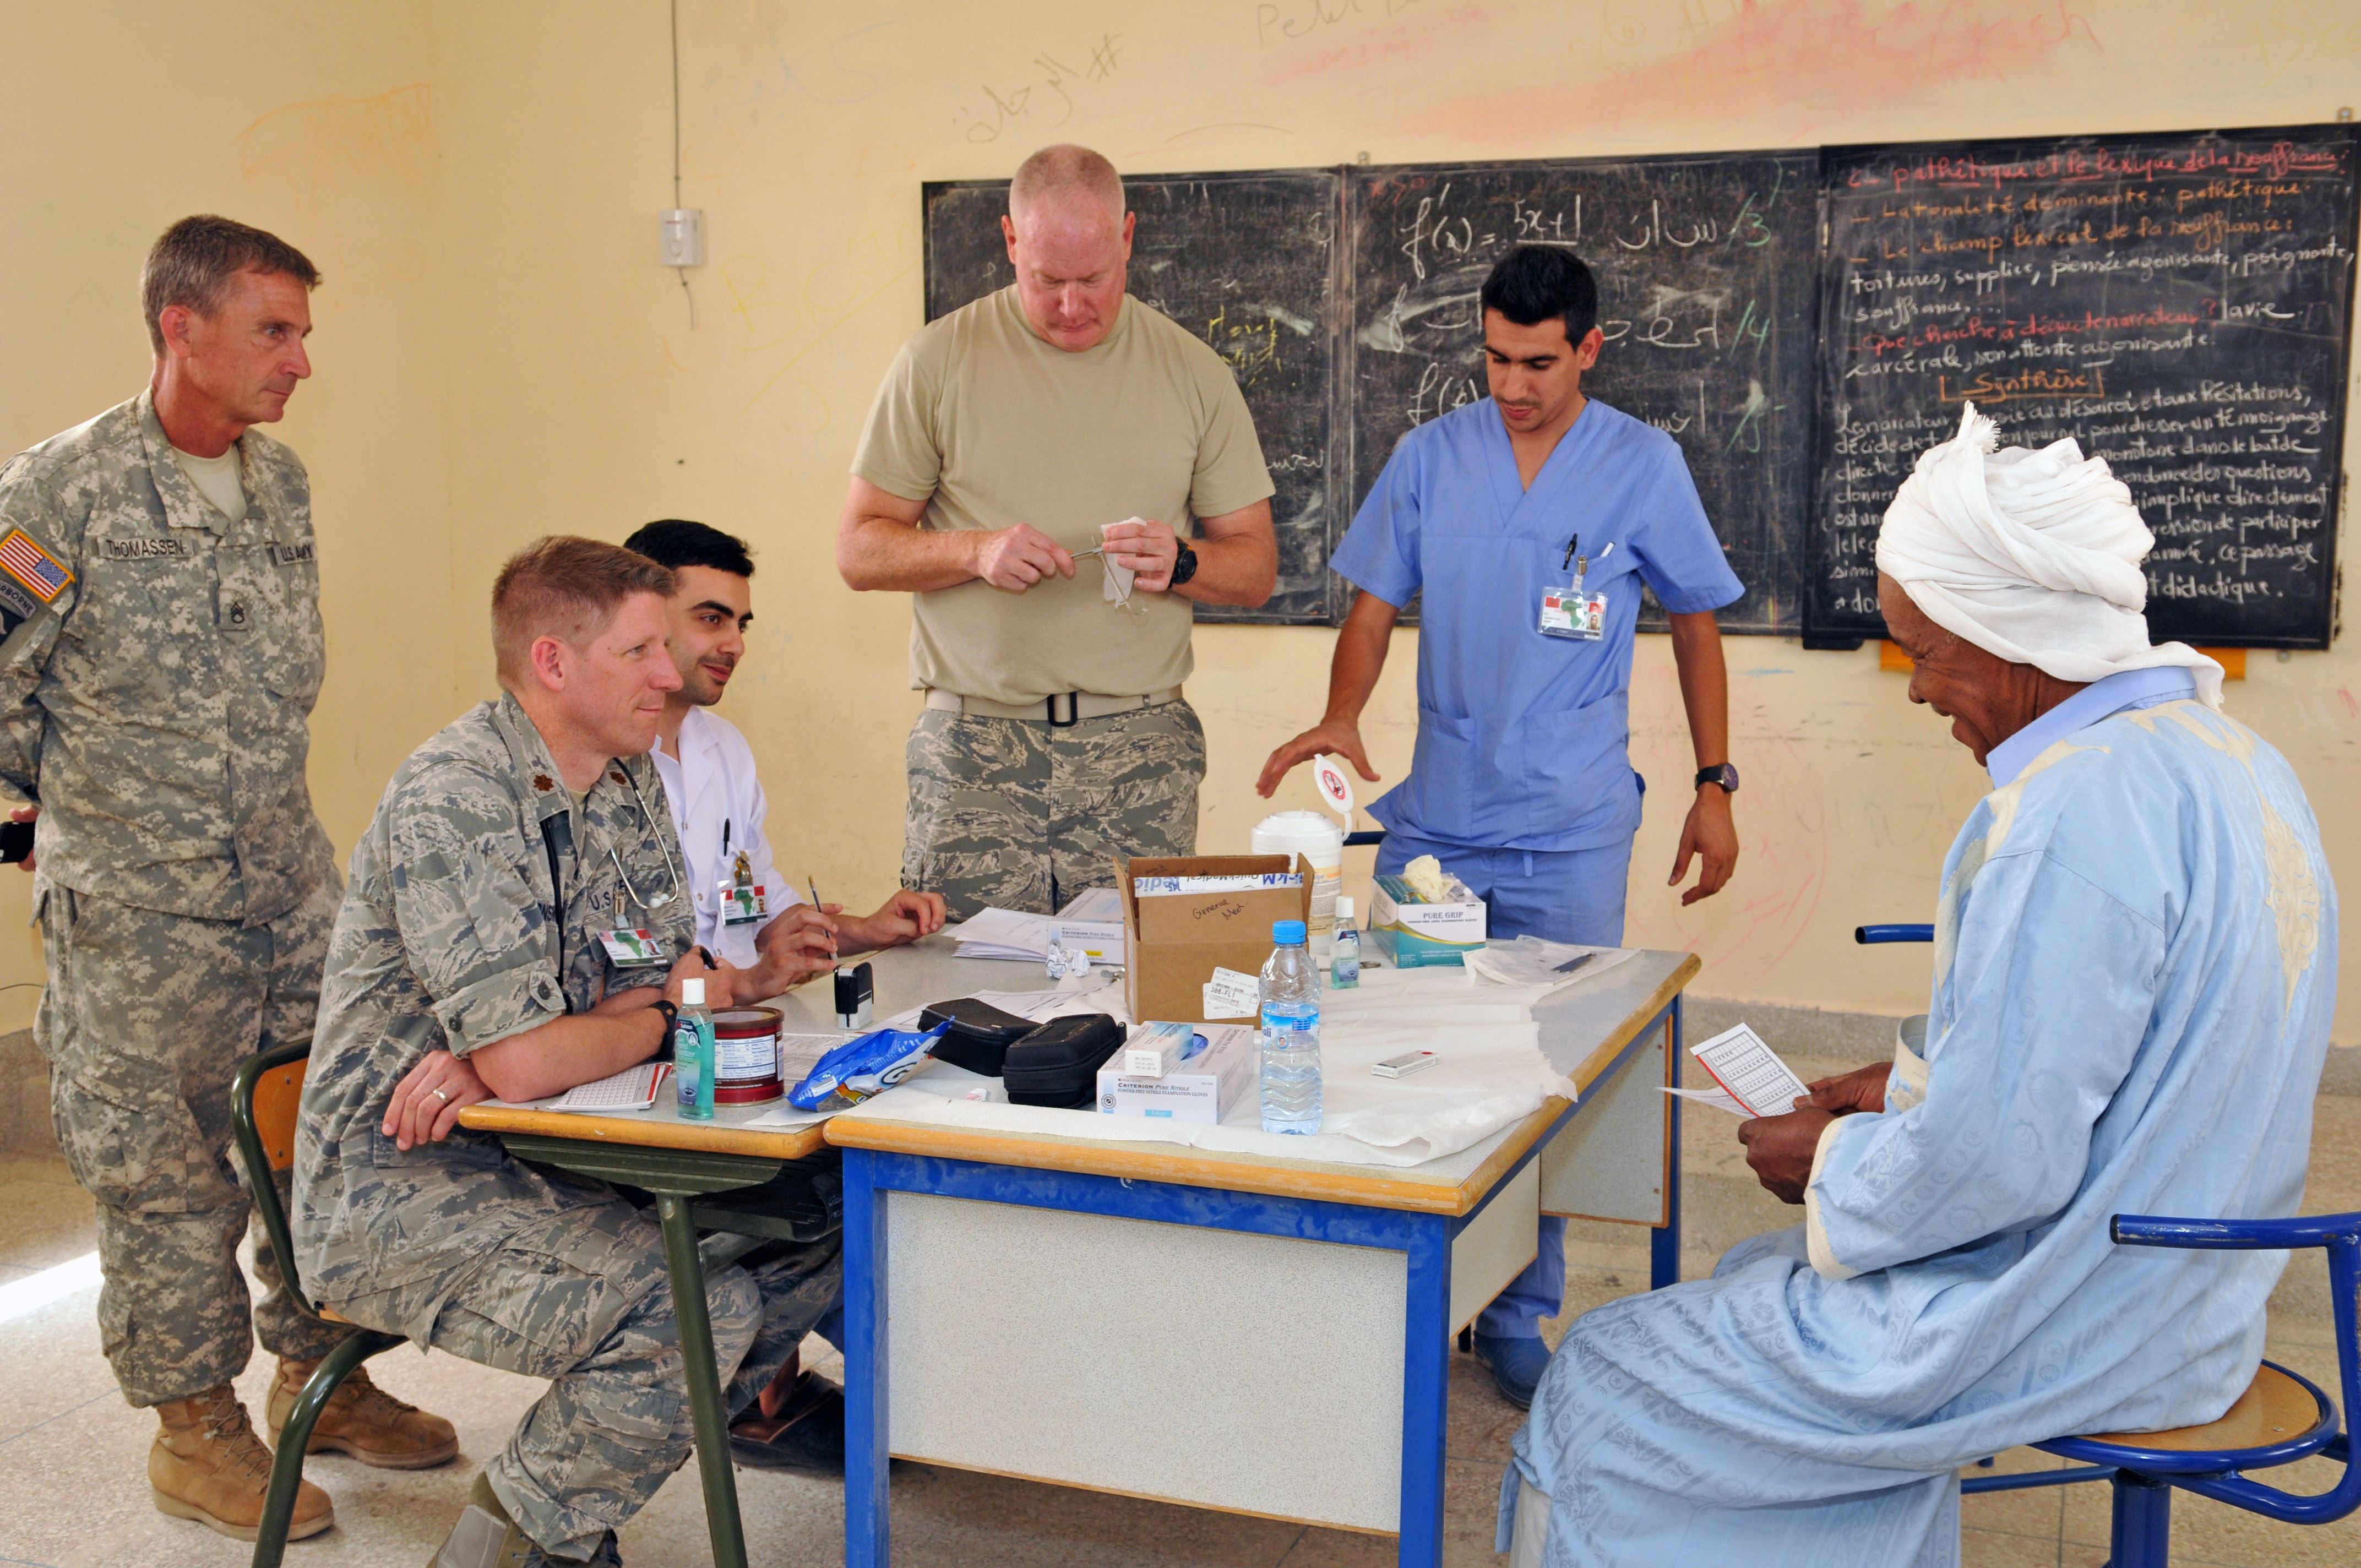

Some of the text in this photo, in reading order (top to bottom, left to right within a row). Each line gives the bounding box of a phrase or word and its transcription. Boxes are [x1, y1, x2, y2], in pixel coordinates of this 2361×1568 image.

[1892, 152, 2029, 194] pathétique
[2036, 154, 2059, 178] et
[107, 539, 183, 557] THOMASSEN
